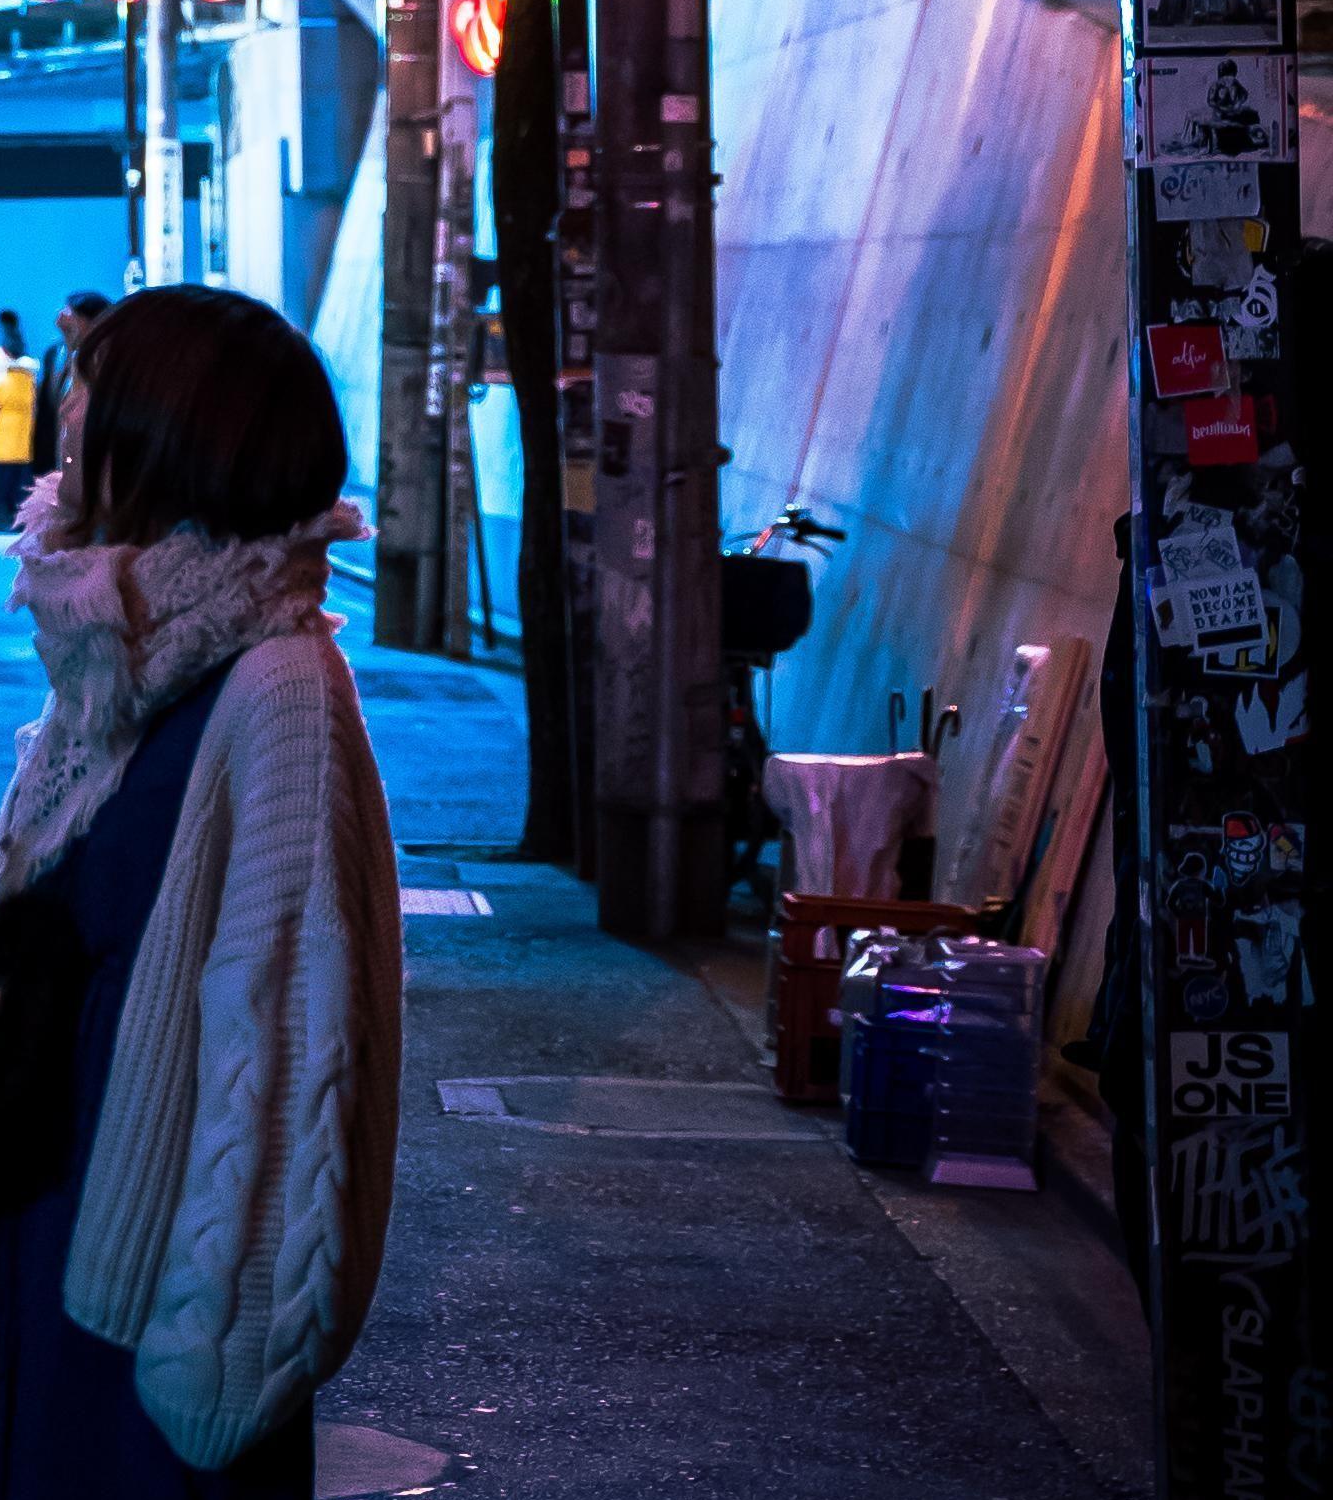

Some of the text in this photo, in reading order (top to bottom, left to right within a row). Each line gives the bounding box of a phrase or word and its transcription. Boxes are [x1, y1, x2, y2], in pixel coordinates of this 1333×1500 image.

[1188, 586, 1222, 601] NOW
[1232, 580, 1255, 595] AM
[1191, 594, 1257, 616] BECOME
[1194, 608, 1259, 630] DEATH
[1186, 1033, 1275, 1080] JS
[1174, 1082, 1290, 1116] ONE
